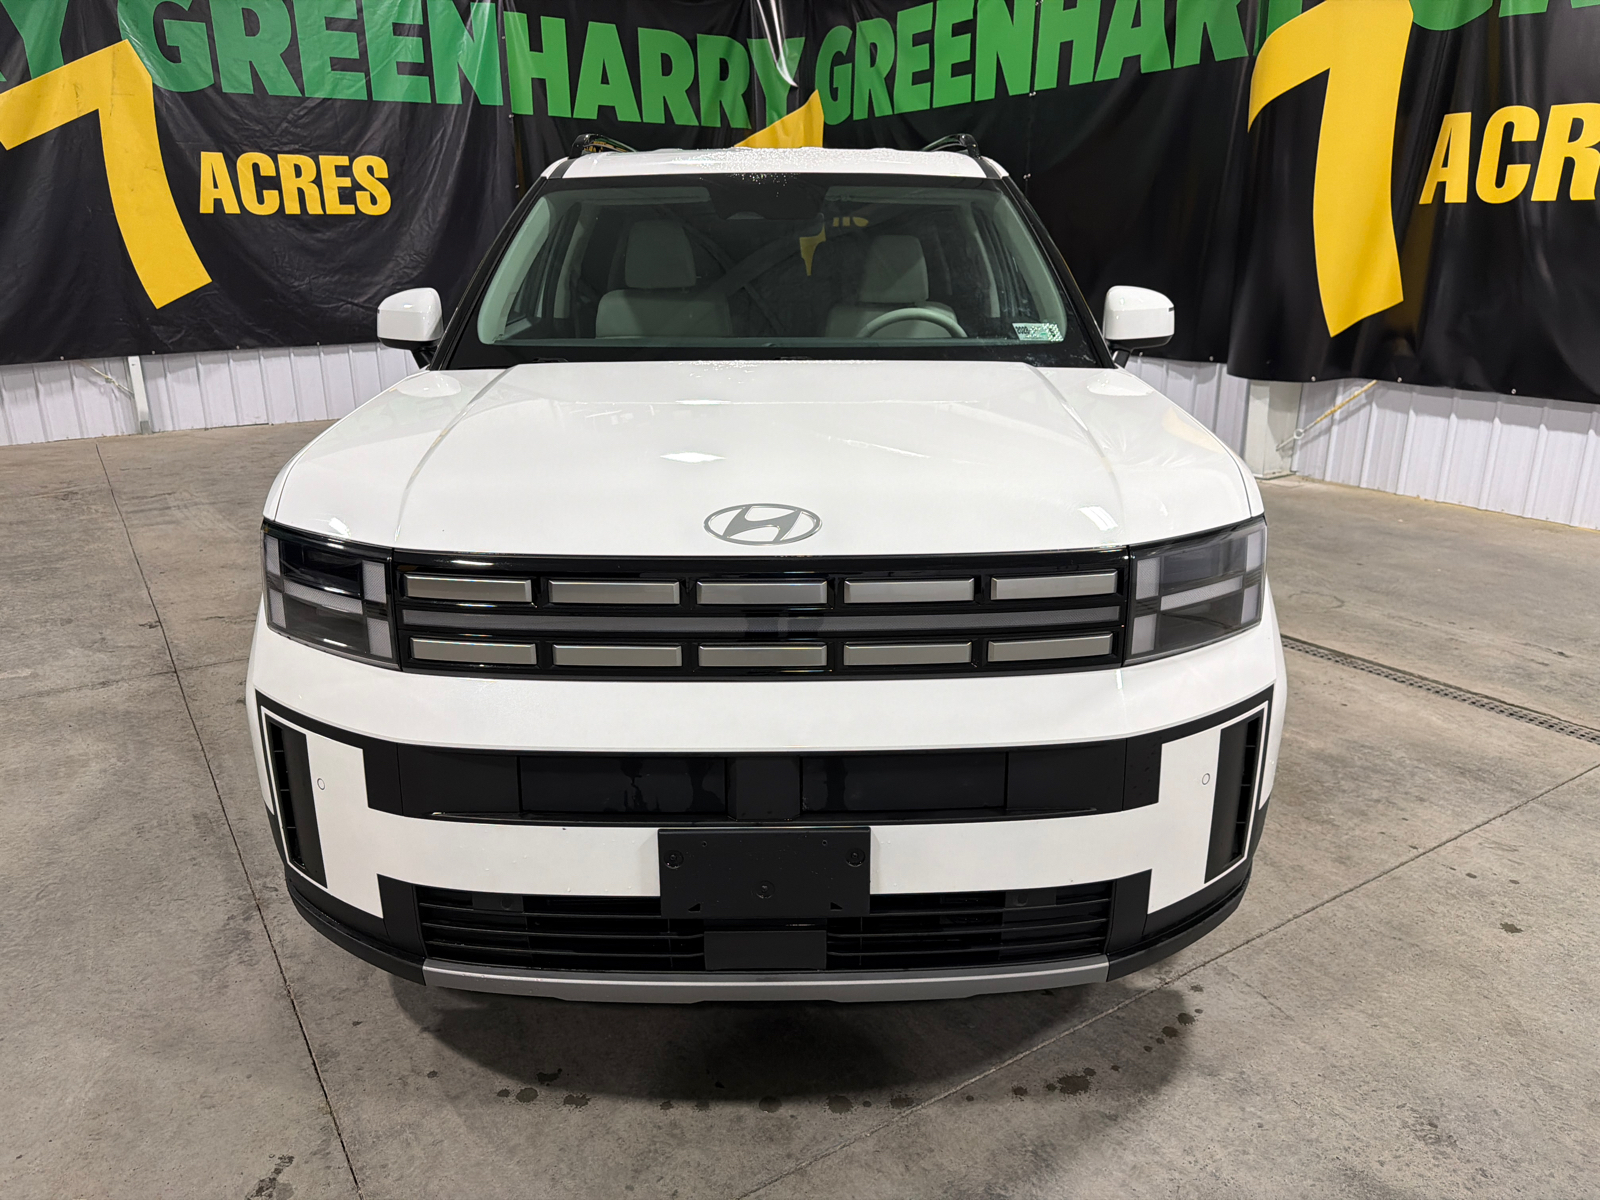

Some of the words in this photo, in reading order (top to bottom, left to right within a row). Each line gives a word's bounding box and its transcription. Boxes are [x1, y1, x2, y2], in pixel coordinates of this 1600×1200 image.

[117, 0, 504, 106] GREEN
[503, 10, 806, 129] HARRY
[815, 0, 1036, 125] GREEN
[199, 151, 392, 216] ACRES
[1419, 102, 1600, 205] ACR
